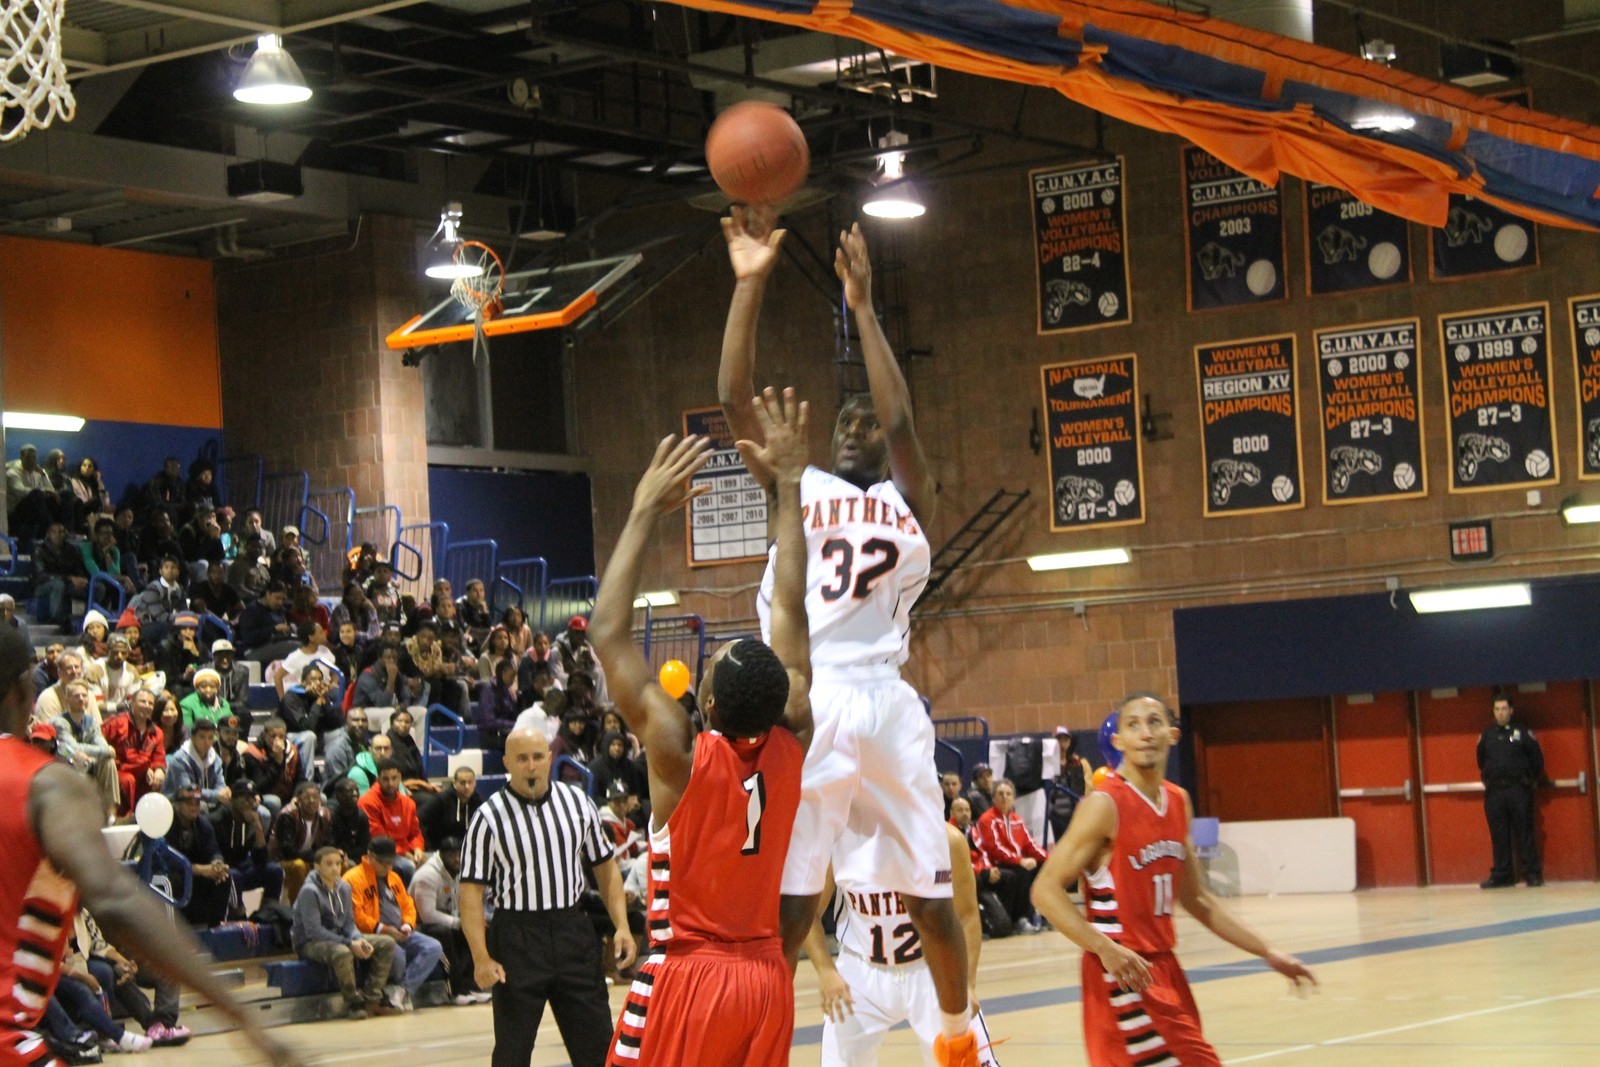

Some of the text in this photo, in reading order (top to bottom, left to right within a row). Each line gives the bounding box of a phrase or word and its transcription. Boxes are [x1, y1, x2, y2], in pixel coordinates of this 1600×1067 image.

[1035, 168, 1119, 193] C.U.N.Y.A.C.
[1189, 164, 1236, 181] VOLLE
[1063, 192, 1094, 211] 2001
[1048, 207, 1111, 227] WOMEN'S
[1192, 200, 1277, 226] CHAMPIONS
[1041, 221, 1117, 241] VOLLEYBALL
[1219, 217, 1251, 237] 2003
[1040, 232, 1120, 264] CHAMPIONS
[1446, 316, 1543, 340] C.U.N.Y.A.C.
[1212, 342, 1280, 363] WOMEN'S
[1320, 331, 1414, 354] C.U.N.Y.A.C.
[1477, 339, 1514, 360] 1999
[1050, 360, 1128, 386] NATIONAL
[1205, 356, 1288, 377] VOLLEYBALL
[1349, 354, 1387, 374] 2000
[1459, 357, 1534, 378] WOMEN'S
[1204, 374, 1290, 397] REGION XV
[1334, 371, 1405, 391] WOMEN'S
[1452, 371, 1542, 392] VOLLEYBALL
[1050, 389, 1132, 413] TOURNAMENT
[1327, 385, 1412, 405] VOLLEYBALL
[1452, 384, 1546, 418] CHAMPIONS
[1205, 396, 1292, 426] CHAMPIONS
[1325, 398, 1416, 430] CHAMPIONS
[1477, 404, 1522, 427] 27-3
[1060, 416, 1124, 435] WOMEN'S
[1350, 417, 1392, 439] 27-3
[1054, 429, 1131, 448] VOLLEYBALL
[1232, 434, 1269, 455] 2000
[702, 452, 745, 469] .U.N.Y.
[1077, 446, 1111, 466] 2000
[720, 494, 738, 506] 2002
[744, 491, 762, 503] 2004
[721, 511, 738, 523] 2007
[745, 508, 763, 520] 2010
[1078, 500, 1117, 520] 27-3
[820, 537, 900, 603] 32
[741, 769, 767, 856] 1
[1152, 873, 1174, 917] 11
[869, 922, 923, 966] 12
